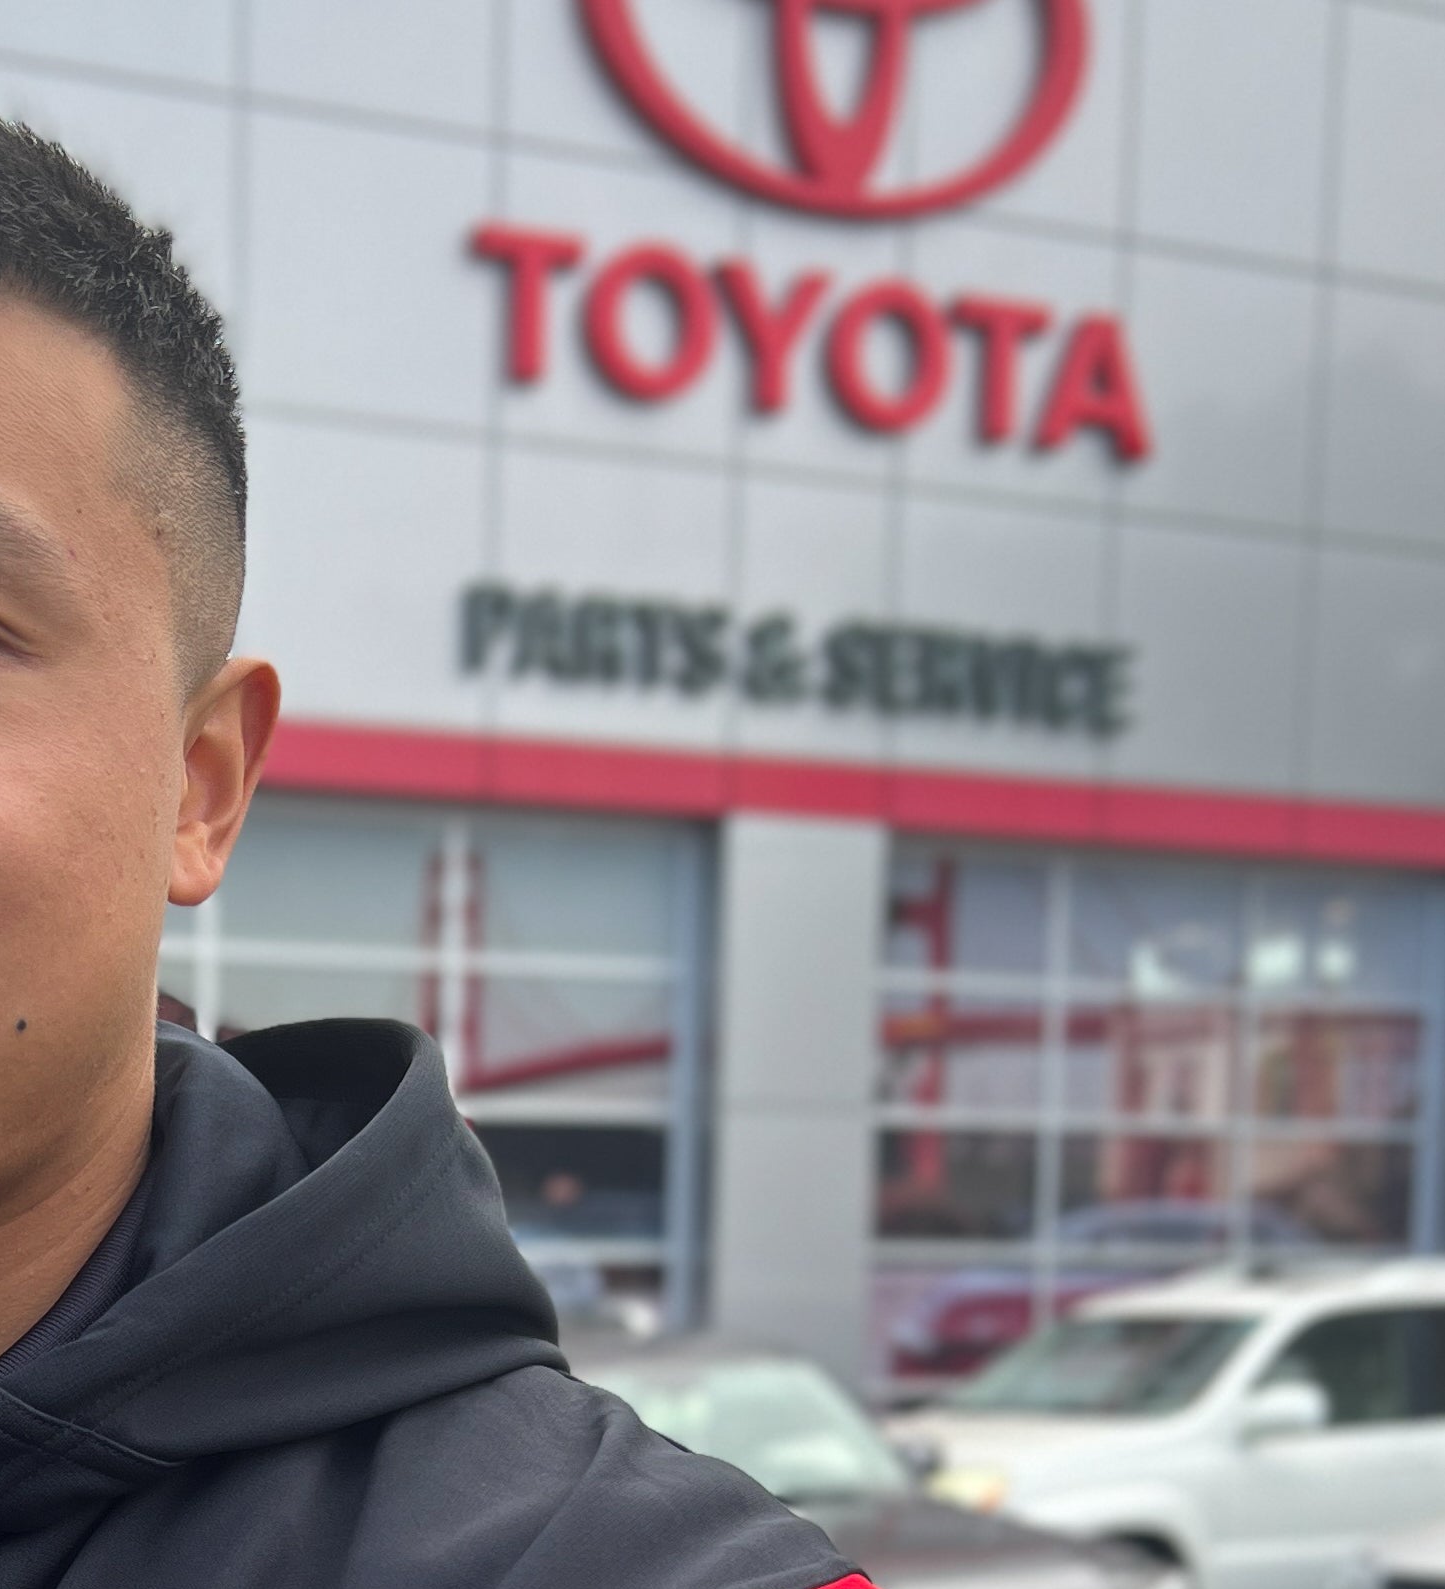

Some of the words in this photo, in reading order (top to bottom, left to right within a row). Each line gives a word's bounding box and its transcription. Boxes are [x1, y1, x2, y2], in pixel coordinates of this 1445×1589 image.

[468, 222, 1153, 464] TOYOTA
[460, 582, 730, 697] PARTS
[740, 612, 806, 706] &
[819, 618, 1136, 740] SERVICE
